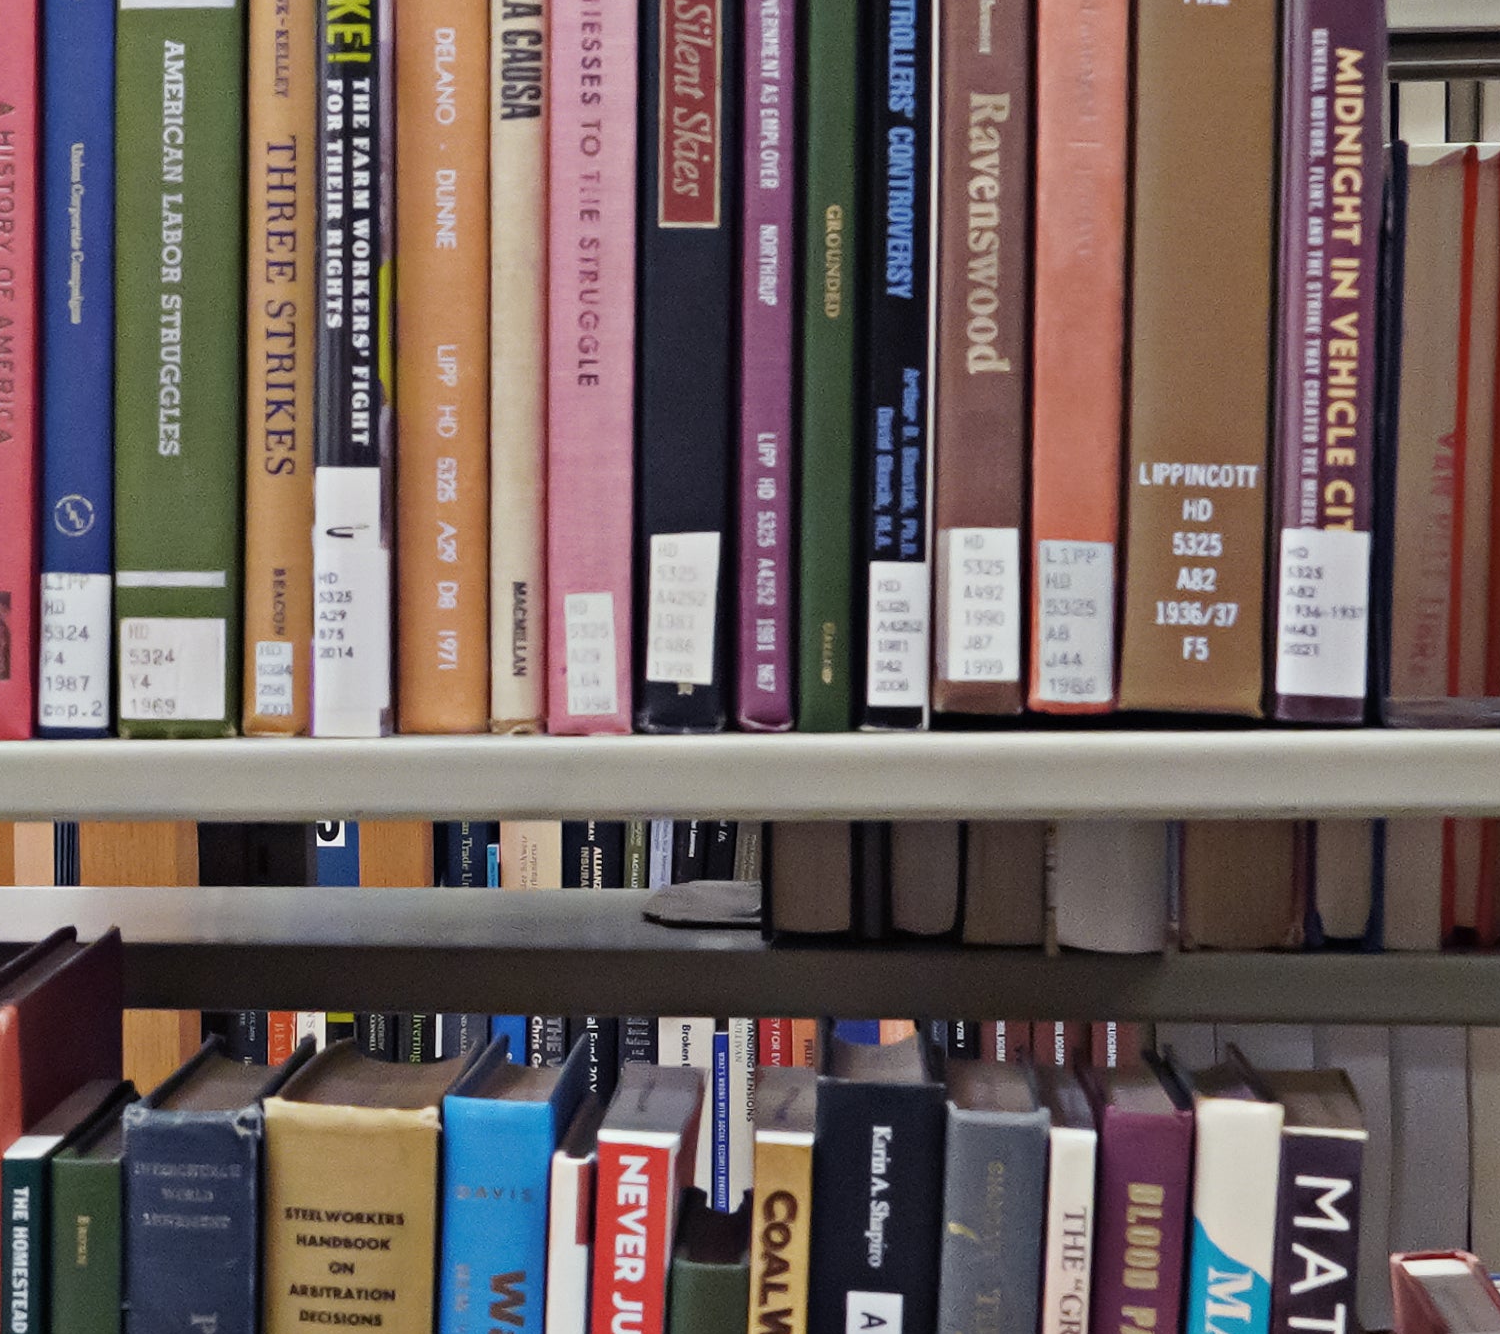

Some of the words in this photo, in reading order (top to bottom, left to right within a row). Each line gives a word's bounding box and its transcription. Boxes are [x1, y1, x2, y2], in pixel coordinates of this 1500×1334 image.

[435, 27, 456, 125] DELANO
[500, 26, 543, 120] CAUSA
[672, 0, 711, 98] Silent
[160, 39, 186, 184] AMERICAN
[325, 79, 344, 131] FOR
[352, 77, 371, 109] THE
[325, 139, 344, 227] THEIR
[351, 115, 371, 204] FARM
[672, 106, 711, 197] Skies
[1331, 48, 1364, 244] MIDNIGHT
[160, 193, 184, 282] LABOR
[265, 138, 297, 284] THREE
[436, 169, 457, 250] DUNNE
[886, 127, 915, 299] CONTROVERSY
[966, 92, 1011, 375] Ravenswood
[325, 236, 343, 329] RIGHTS
[1329, 258, 1360, 298] IN
[158, 293, 182, 456] STRUGGLES
[264, 299, 296, 476] STRIKES
[350, 366, 371, 445] FIGHT
[1326, 312, 1359, 467] VEHICLE
[1138, 462, 1260, 488] LIPPINCOTT
[1182, 499, 1213, 522] HD
[1172, 532, 1224, 557] 5325
[1176, 567, 1217, 591] A82
[1156, 601, 1239, 627] 1936/37
[1182, 637, 1210, 661] F5
[681, 1024, 692, 1060] Broken
[745, 1069, 756, 1123] PENSIONS
[12, 1186, 30, 1224] THE
[284, 1207, 405, 1226] STEELWORKERS
[296, 1234, 391, 1251] HANDBOOK
[613, 1155, 649, 1284] NEVER
[1060, 1207, 1087, 1272] THE
[1121, 1182, 1164, 1290] BLOOD
[11, 1229, 30, 1334] HOMESTEAD
[328, 1261, 355, 1276] ON
[758, 1189, 798, 1307] COAL
[289, 1284, 396, 1302] ARBITRATION
[299, 1309, 383, 1327] DECISIONS
[859, 1311, 887, 1329] A
